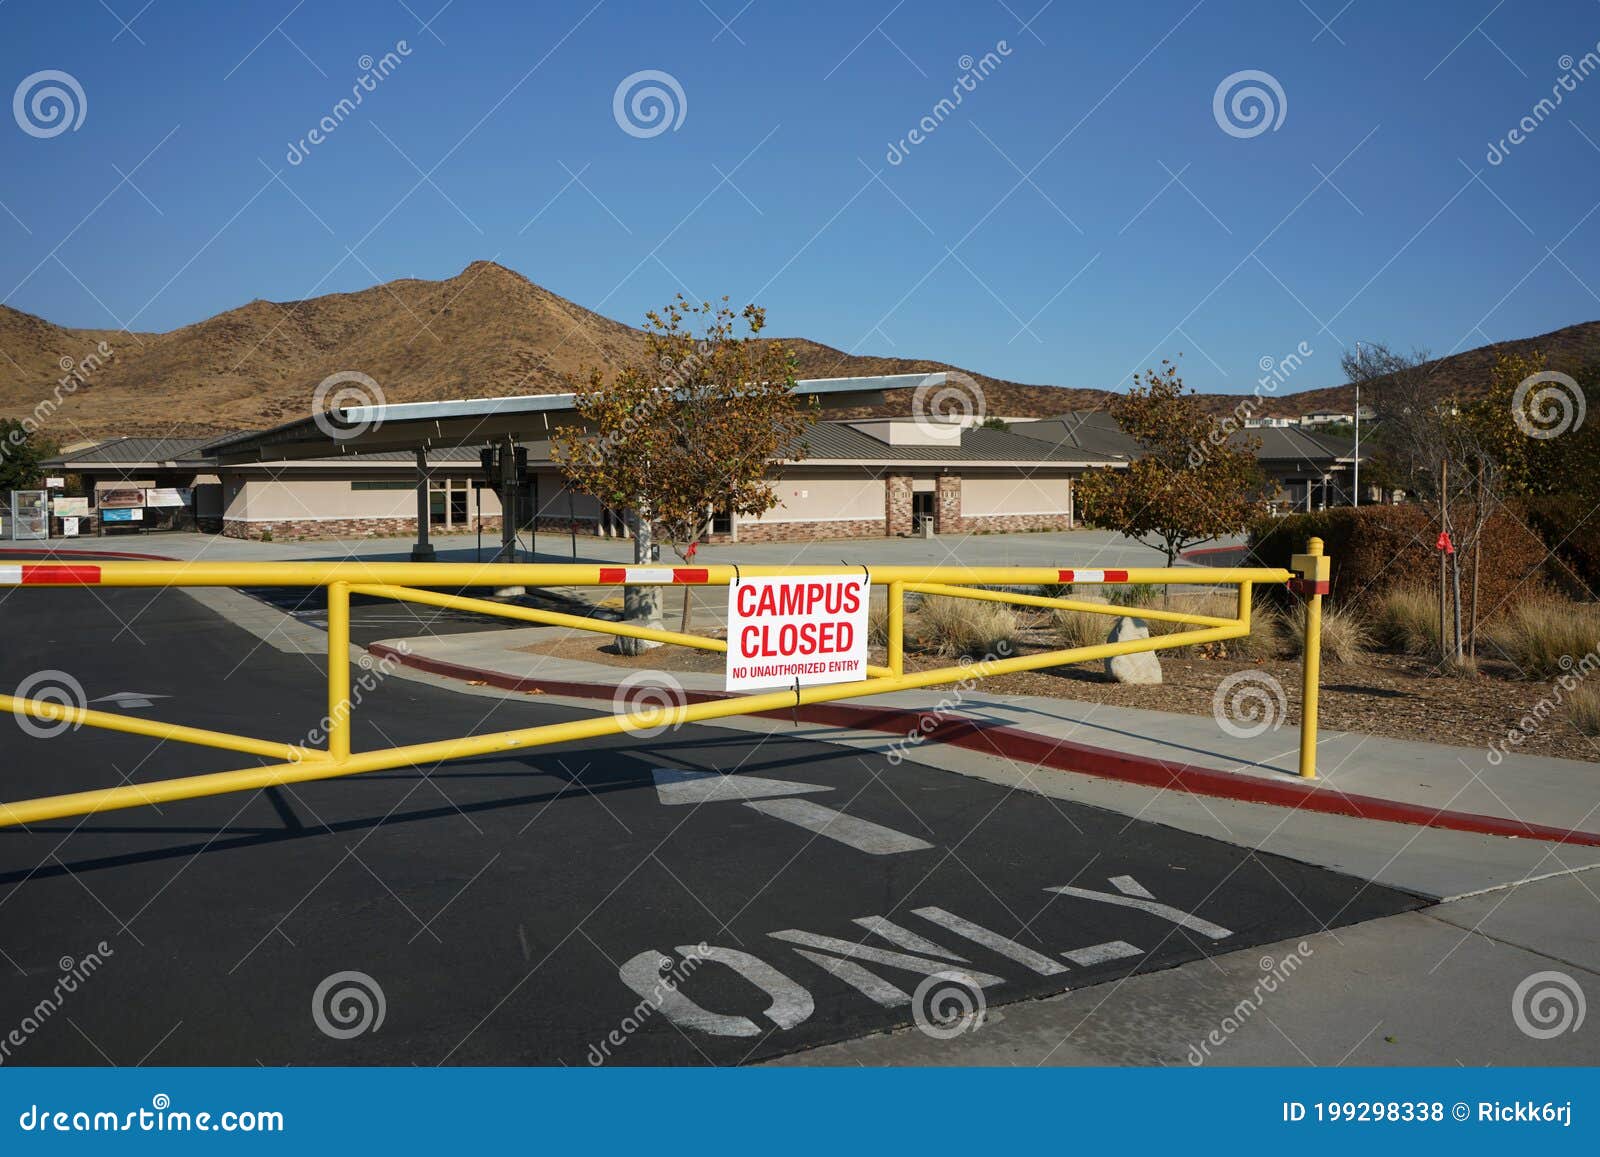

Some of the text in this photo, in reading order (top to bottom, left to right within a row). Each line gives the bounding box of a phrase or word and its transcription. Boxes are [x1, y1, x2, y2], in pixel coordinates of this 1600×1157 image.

[737, 582, 860, 617] CAMPUS
[740, 621, 854, 659] CLOSED
[732, 660, 859, 679] NO UNAUTHORIZED ENTRY
[619, 875, 1234, 1037] ONLY
